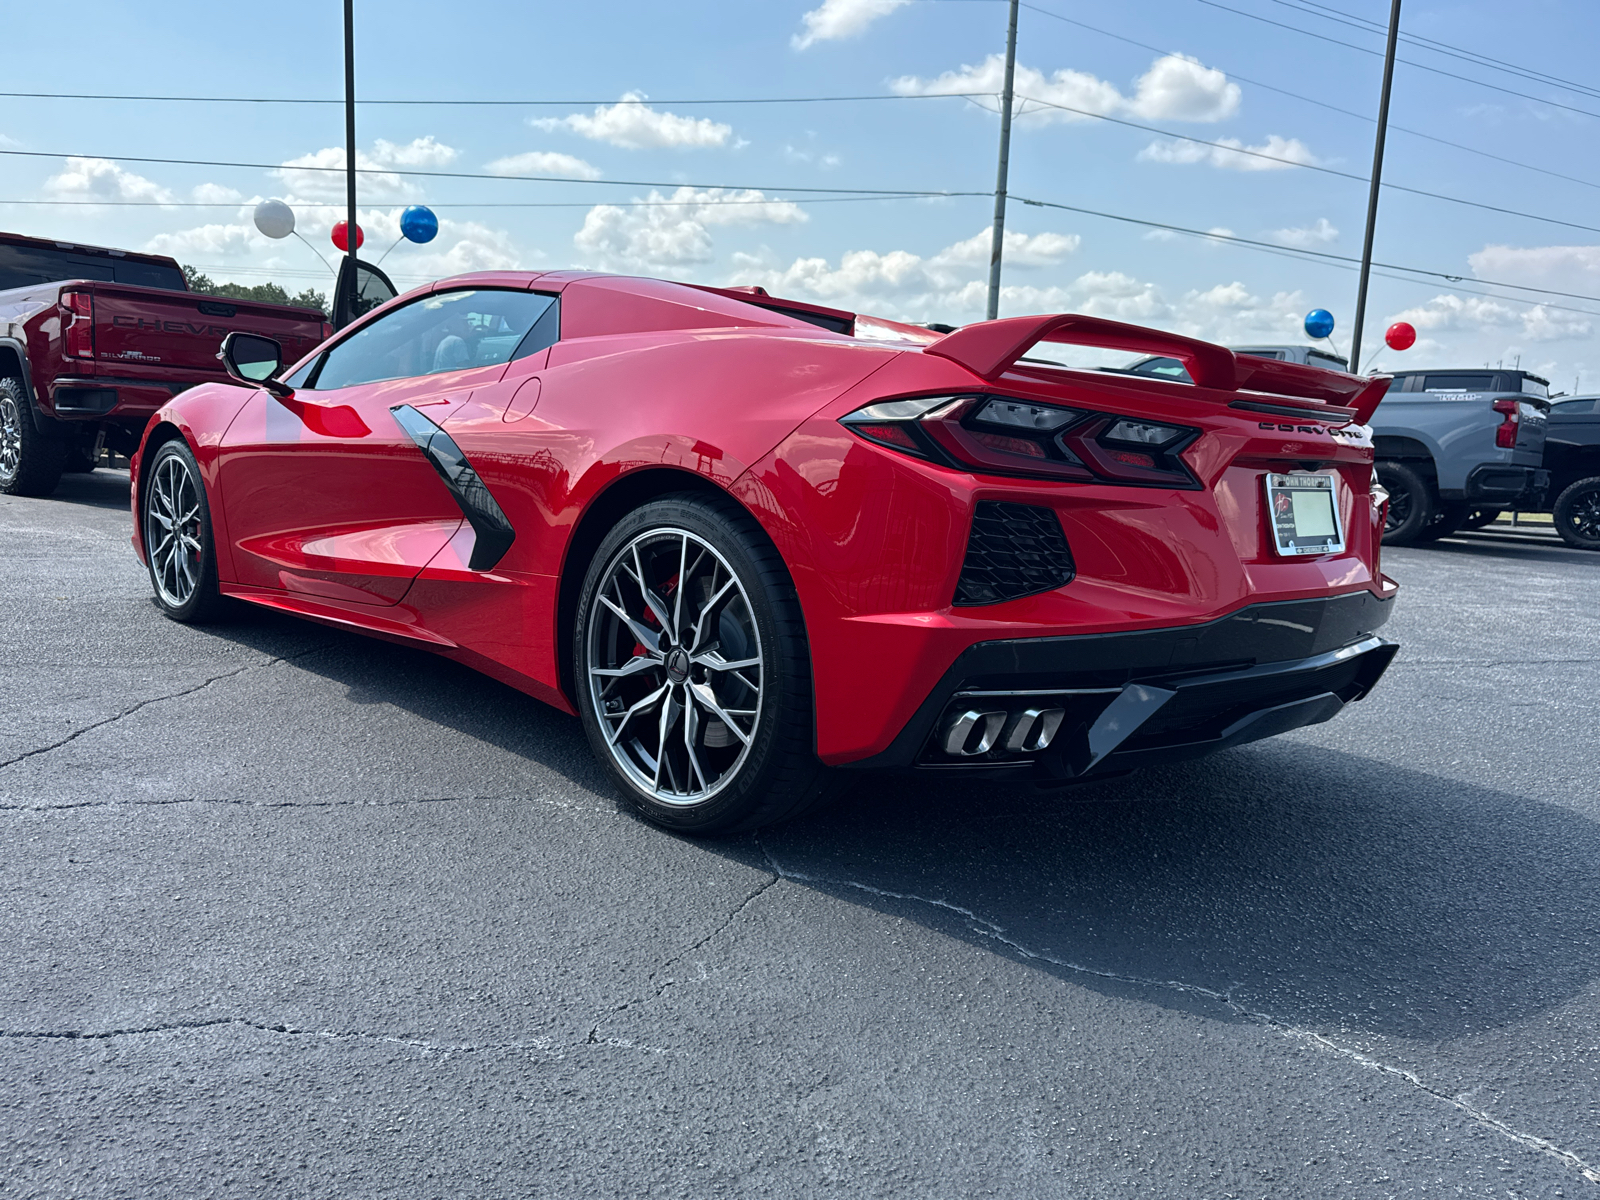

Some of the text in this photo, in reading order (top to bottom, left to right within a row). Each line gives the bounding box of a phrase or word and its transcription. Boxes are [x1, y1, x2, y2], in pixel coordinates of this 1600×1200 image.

[113, 315, 309, 346] CHEVRET
[100, 351, 161, 362] SILVERADO
[1258, 422, 1364, 439] CORVETTE
[646, 535, 676, 545] FORGED
[741, 714, 774, 791] MICHELIN
